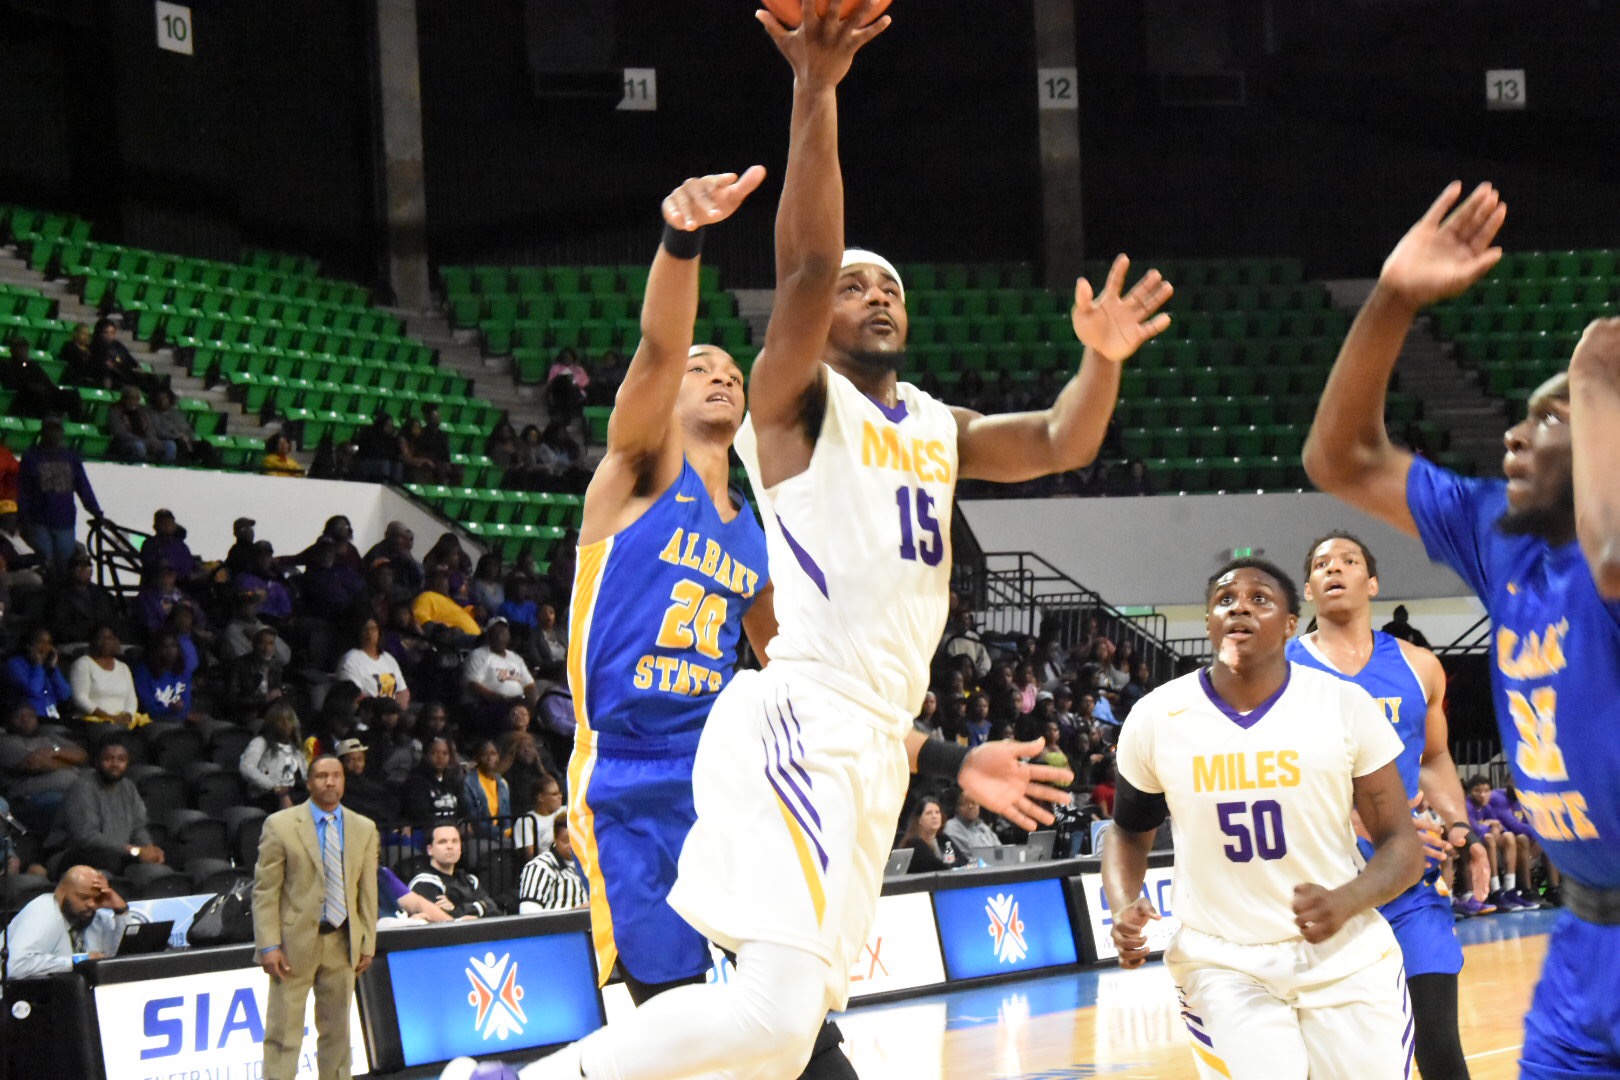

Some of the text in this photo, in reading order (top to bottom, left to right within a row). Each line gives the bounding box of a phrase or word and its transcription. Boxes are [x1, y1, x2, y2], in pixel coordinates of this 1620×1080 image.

[162, 14, 187, 41] 10
[625, 78, 647, 99] 11
[1045, 78, 1071, 99] 12
[1493, 79, 1519, 100] 13
[862, 420, 950, 484] MIES
[896, 485, 944, 567] 15
[659, 527, 759, 599] ALBANY
[656, 578, 728, 660] 20
[633, 655, 723, 696] STATE
[1192, 749, 1300, 793] MILES
[1217, 800, 1287, 862] 50
[140, 988, 309, 1060] SIA
